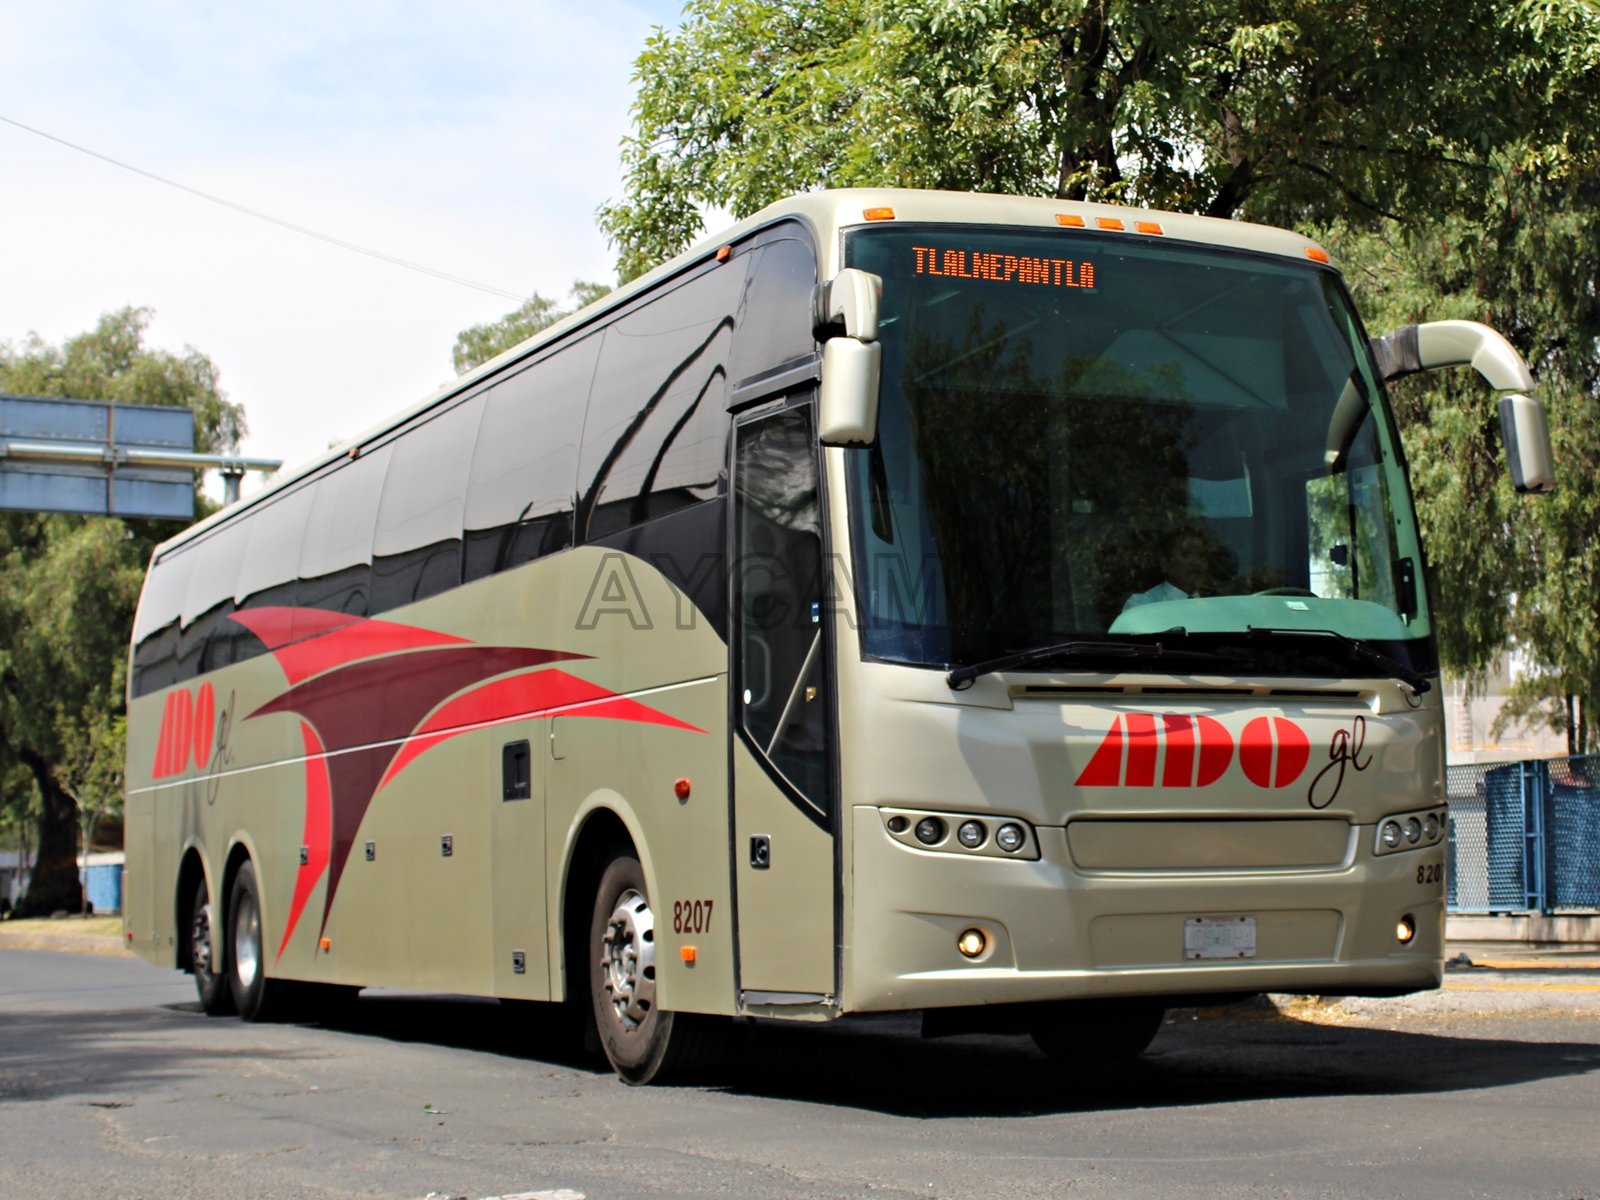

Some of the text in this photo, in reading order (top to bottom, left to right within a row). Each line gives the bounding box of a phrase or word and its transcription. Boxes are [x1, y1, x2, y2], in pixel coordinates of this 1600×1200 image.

[912, 246, 1094, 288] TLALNEPANTLA
[152, 681, 216, 780] ADO
[1073, 713, 1373, 810] ADO gl
[673, 899, 714, 935] 8207
